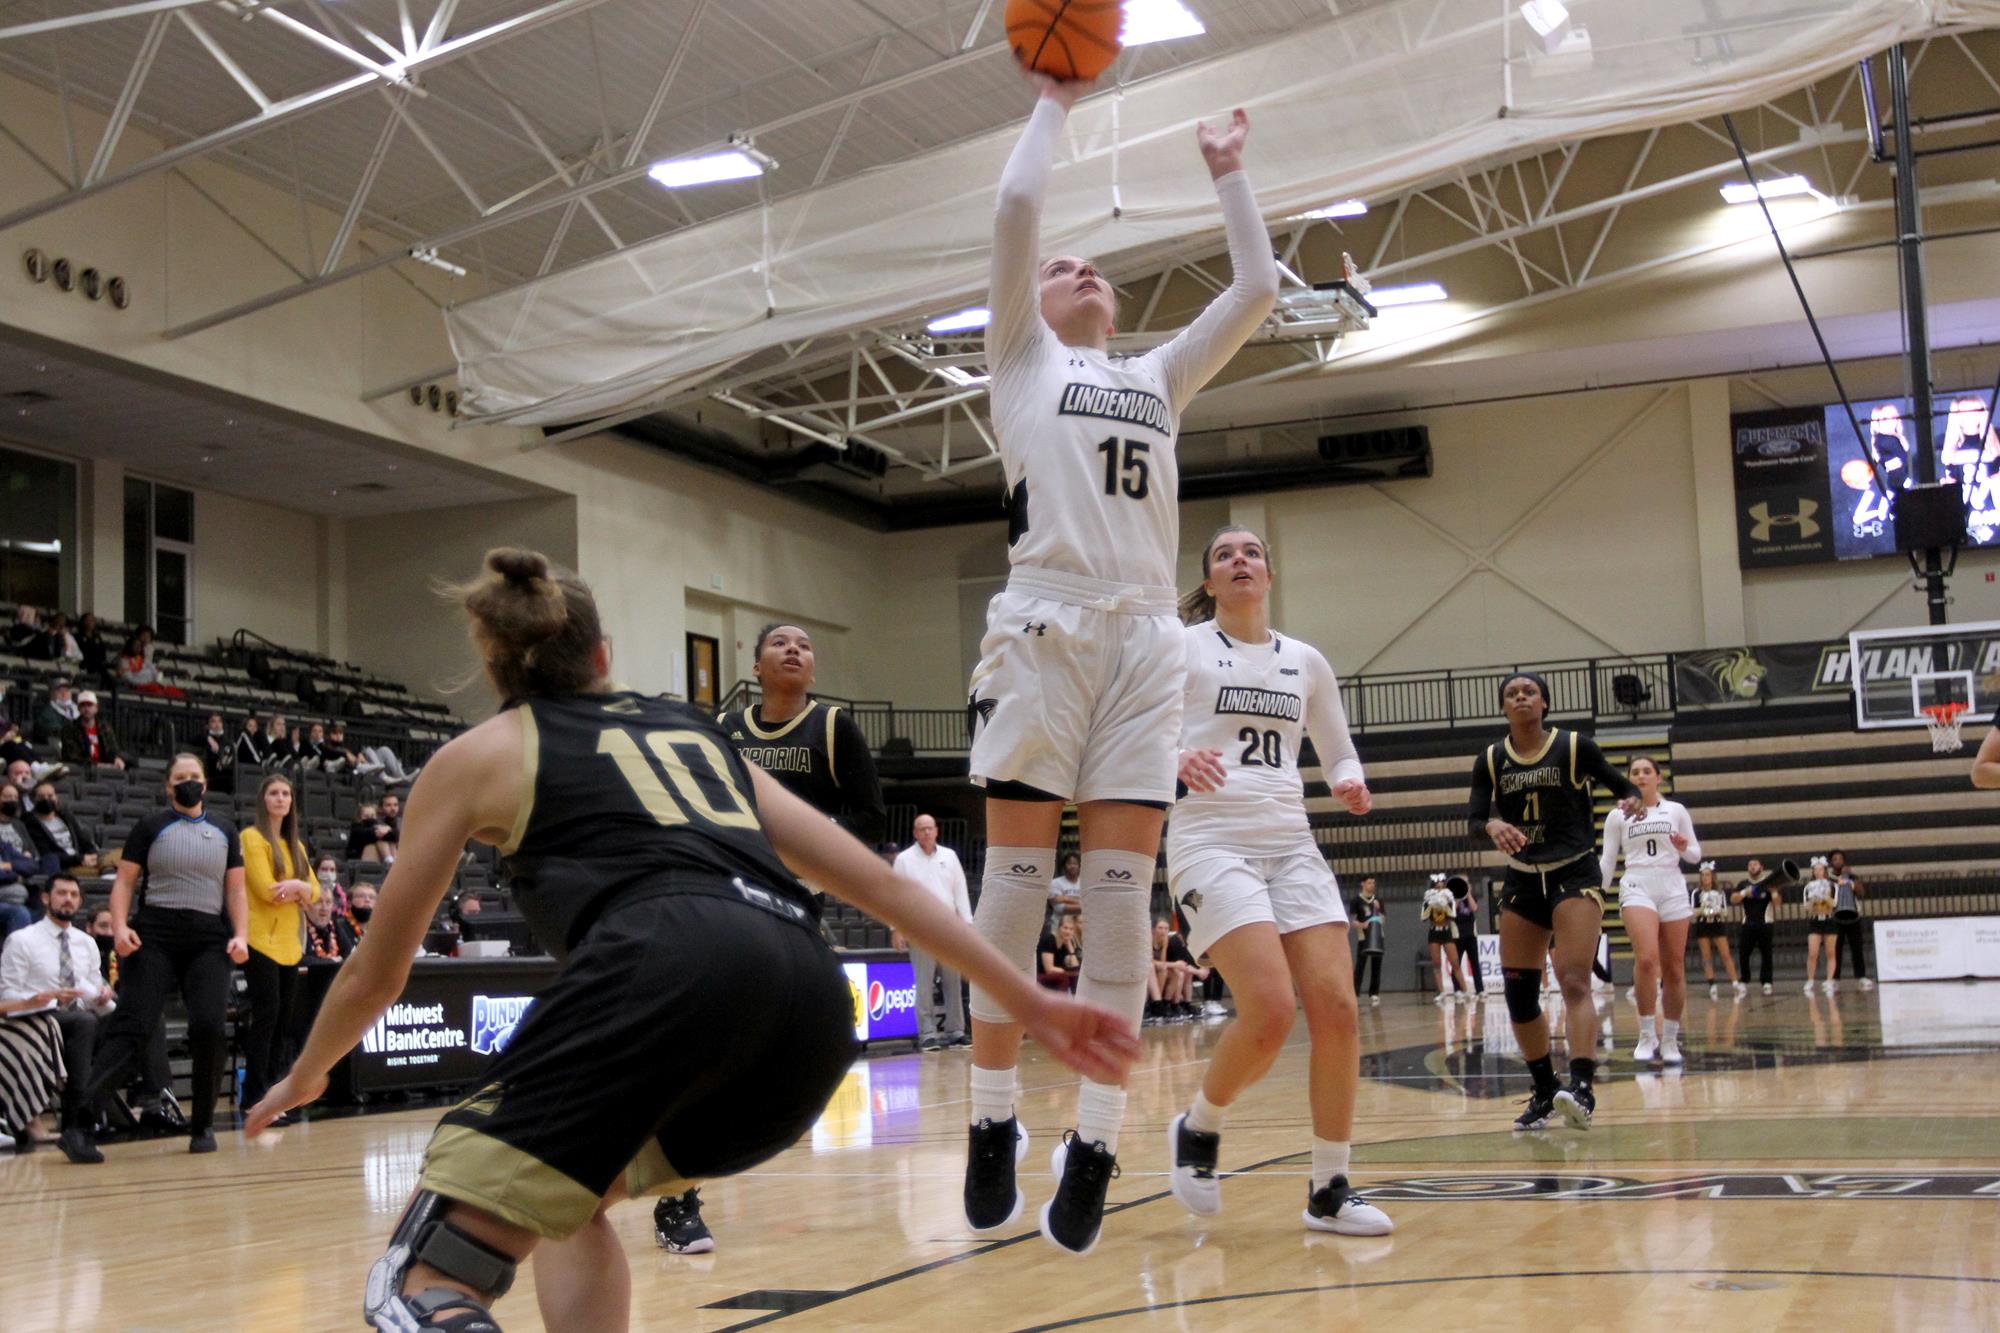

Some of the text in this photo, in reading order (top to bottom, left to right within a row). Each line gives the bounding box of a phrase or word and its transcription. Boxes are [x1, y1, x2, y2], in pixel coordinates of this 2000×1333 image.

[1063, 385, 1171, 434] LINDENWOOD
[1098, 436, 1150, 499] 15
[1219, 689, 1300, 720] LINDENWOOD
[738, 747, 811, 773] PORIA
[1238, 727, 1282, 768] 20
[596, 727, 761, 831] 10
[1500, 767, 1561, 794] EMPORIA
[1629, 822, 1671, 837] LINDENWOOD
[1647, 839, 1657, 857] 0
[885, 985, 917, 1014] pepsi
[386, 1003, 444, 1026] Midwest
